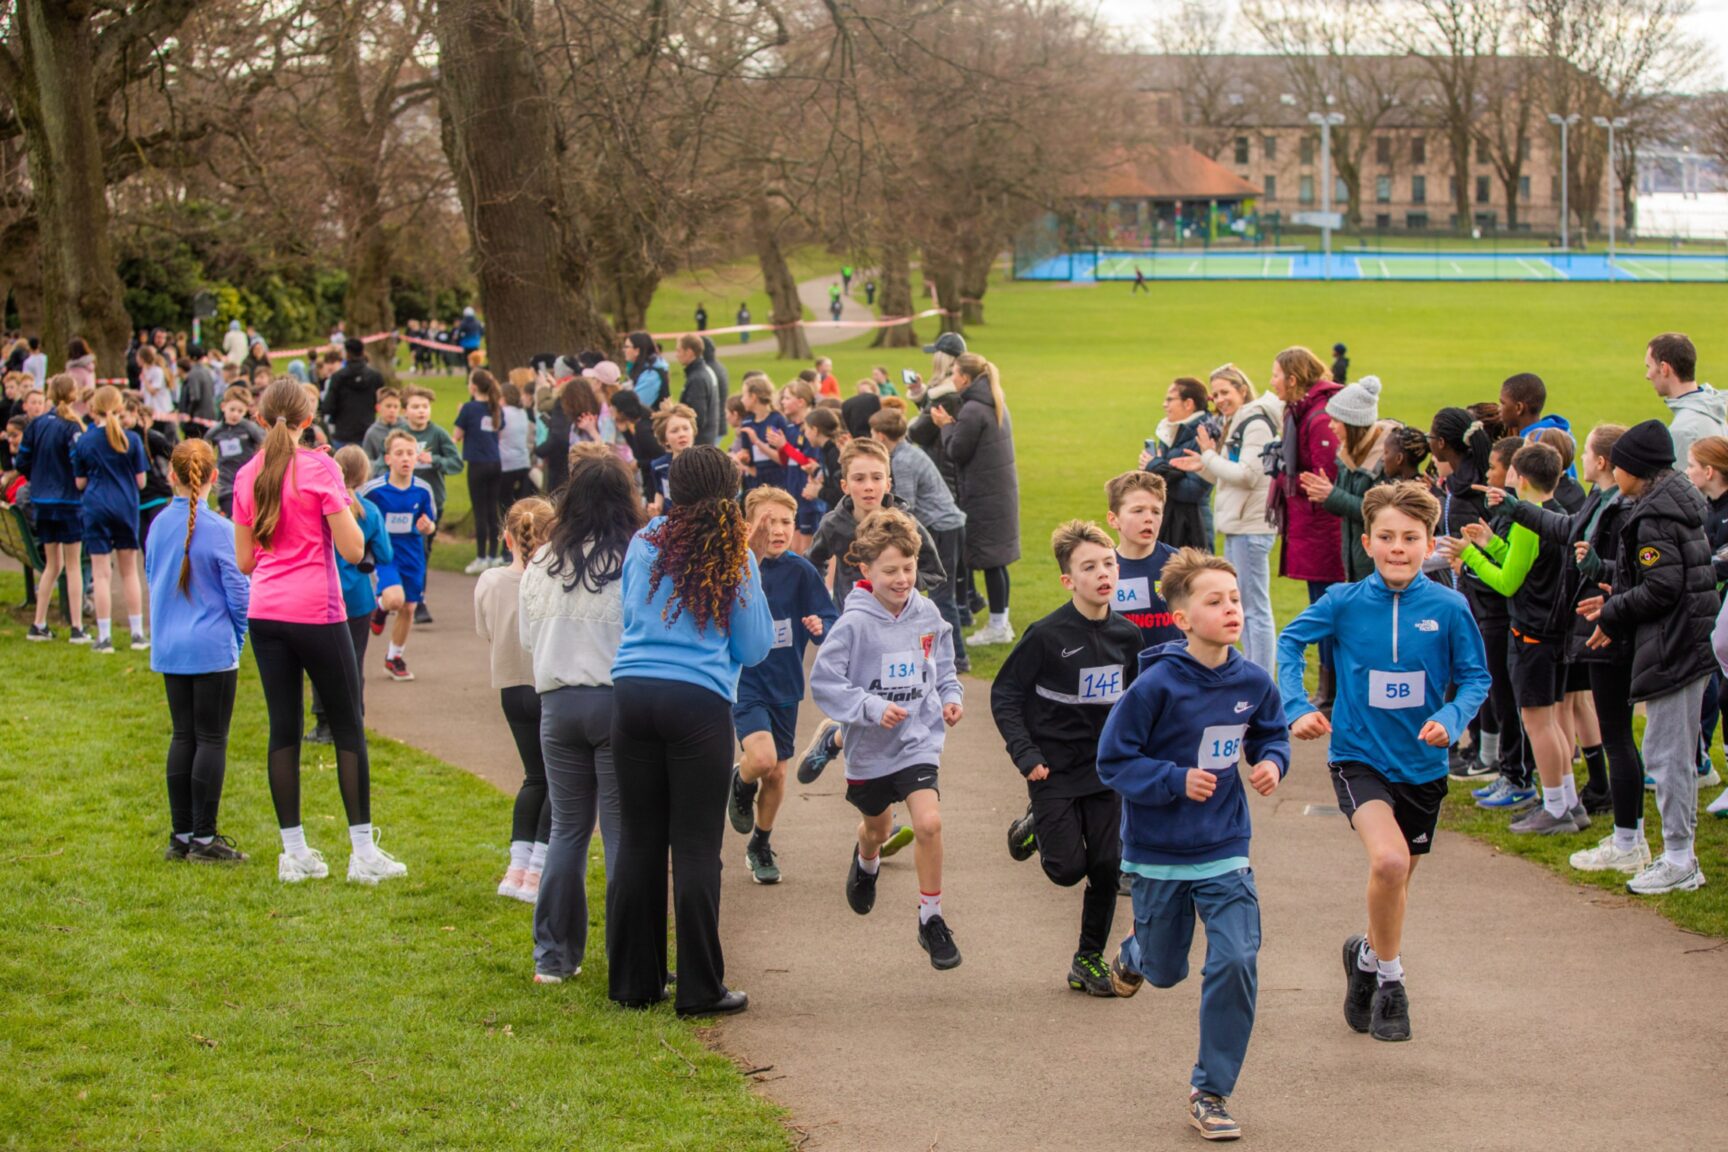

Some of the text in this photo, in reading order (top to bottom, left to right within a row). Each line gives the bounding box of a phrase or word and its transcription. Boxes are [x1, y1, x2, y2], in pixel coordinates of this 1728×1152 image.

[1117, 589, 1137, 602] 8A
[888, 662, 915, 678] 13A
[1385, 682, 1411, 699] 5B
